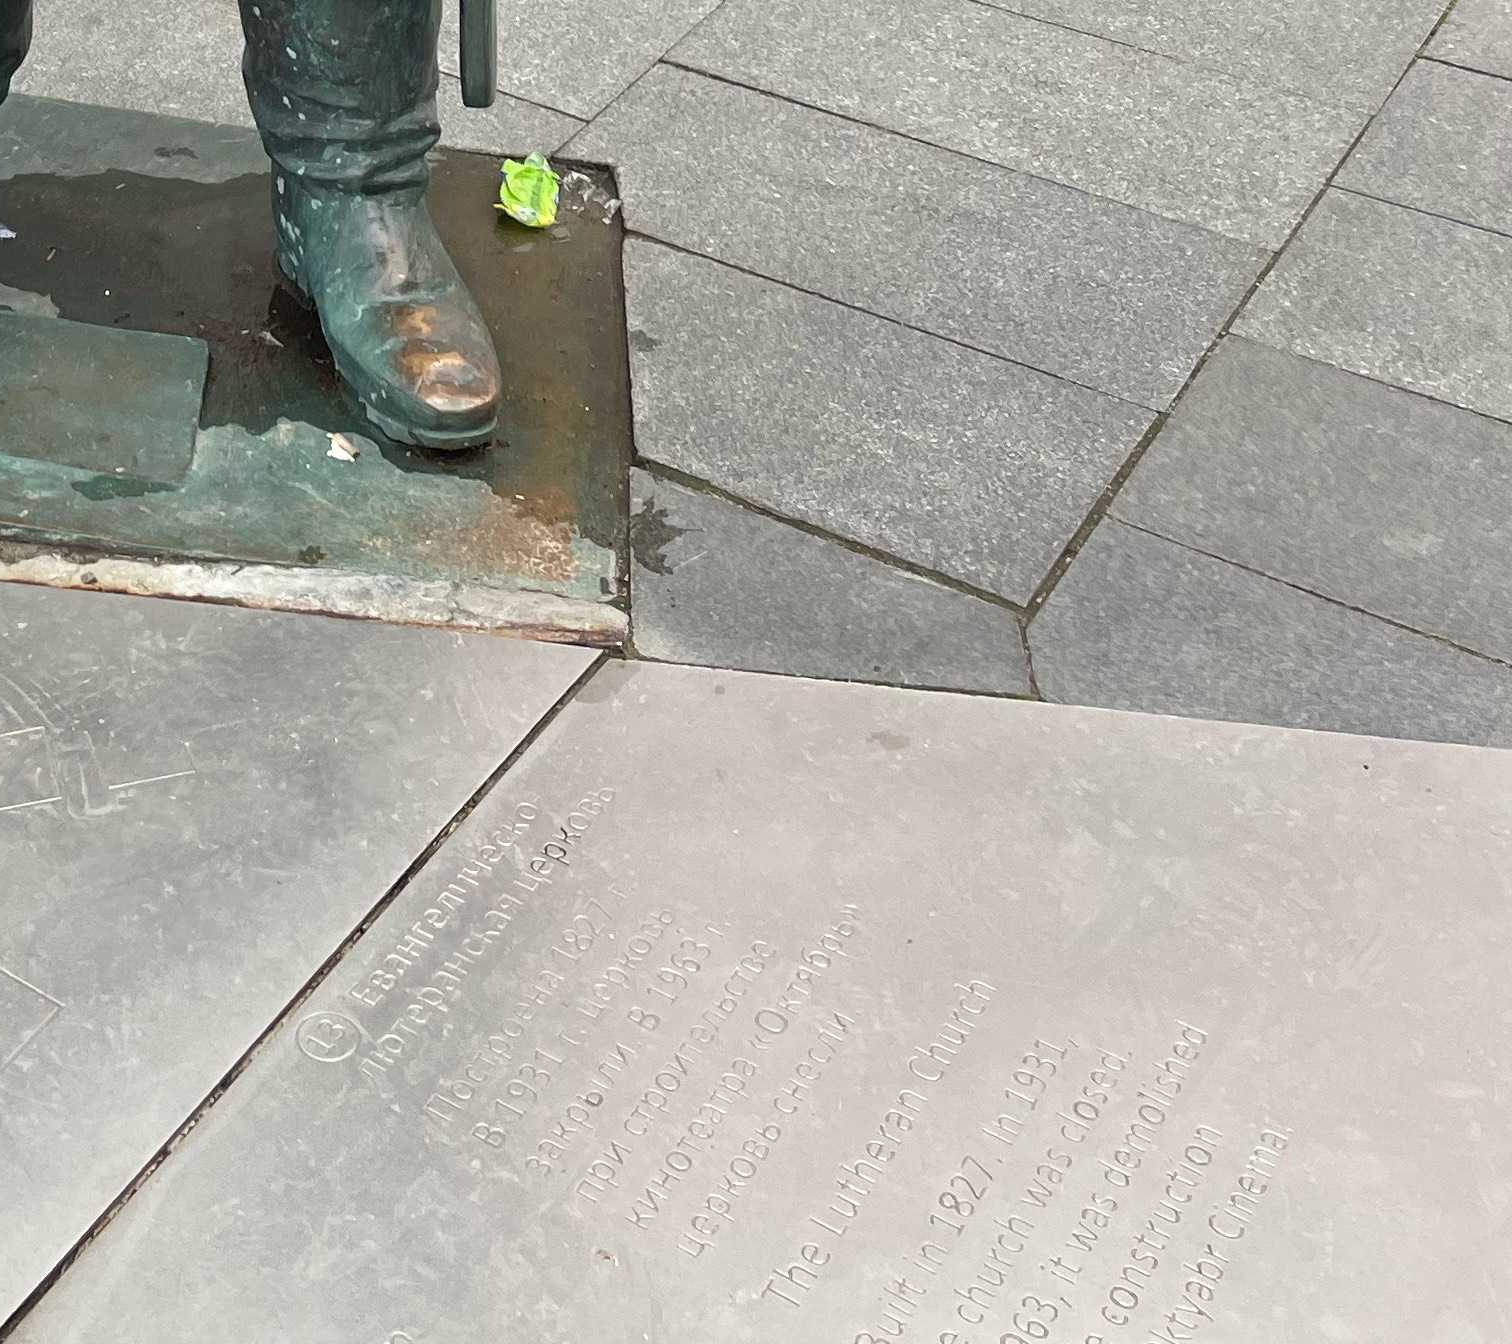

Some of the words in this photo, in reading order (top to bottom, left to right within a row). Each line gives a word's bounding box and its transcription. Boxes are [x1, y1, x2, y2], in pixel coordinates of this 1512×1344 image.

[307, 1018, 346, 1051] 13
[360, 892, 525, 1088] лютеранская
[513, 786, 616, 892] церковь
[423, 969, 566, 1122] Построена
[551, 897, 613, 962] 1827
[471, 1121, 506, 1149] В
[495, 1047, 564, 1119] 1931
[579, 908, 674, 1019] церковь
[627, 1006, 661, 1031] В
[647, 938, 711, 1005] 1963
[576, 1140, 632, 1203] при
[623, 940, 777, 1136] строительстве
[625, 1056, 760, 1230] кинотеатра
[760, 1242, 831, 1308] The
[809, 1089, 929, 1237] Lutheran
[908, 979, 998, 1082] Church
[902, 1242, 949, 1275] in
[929, 1154, 1004, 1237] 1827.
[981, 1113, 1024, 1145] In
[1004, 1038, 1079, 1111] 1931,
[957, 1214, 1035, 1324] church
[1020, 1148, 1073, 1208] was
[1056, 1045, 1133, 1143] closed.
[1039, 1256, 1083, 1285] it
[1064, 1192, 1118, 1252] was
[1097, 1020, 1209, 1188] demolished
[1208, 1127, 1294, 1240] Cinema.
[675, 1124, 782, 1258] церковь
[1101, 1124, 1224, 1326] construction
